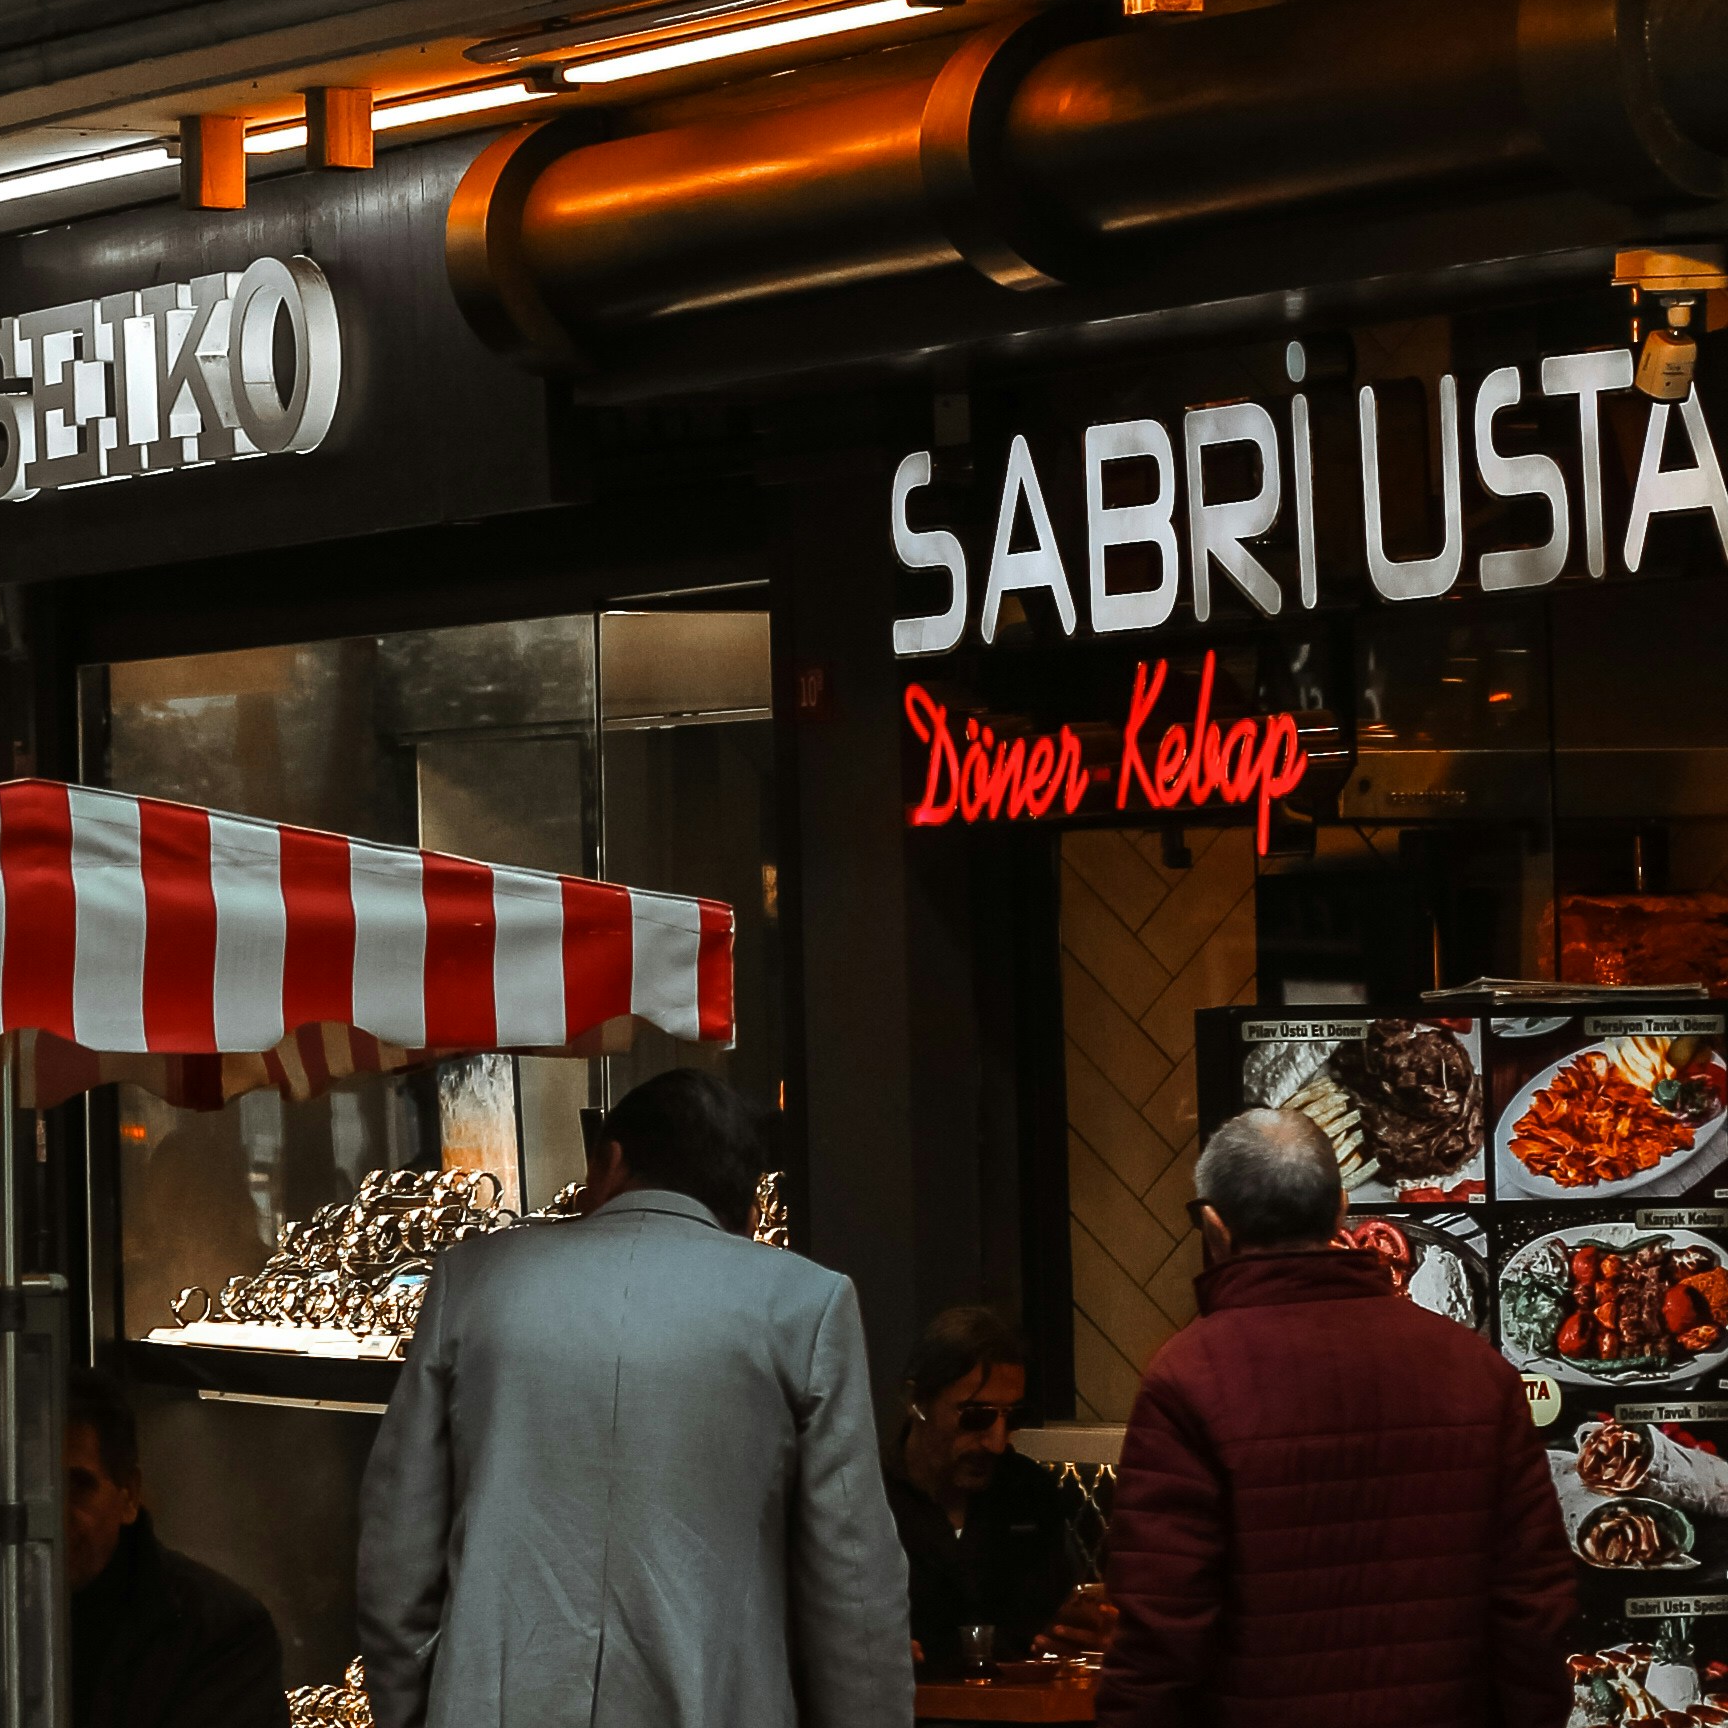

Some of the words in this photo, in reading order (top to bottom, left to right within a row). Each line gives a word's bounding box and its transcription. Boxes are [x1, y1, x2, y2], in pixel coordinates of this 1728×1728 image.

[890, 340, 1318, 657] SABRİ
[1358, 348, 1728, 602] USTA
[904, 680, 1091, 828] Döner
[1117, 648, 1309, 857] Kebap
[1280, 1022, 1310, 1038] Üstü
[1312, 1024, 1325, 1038] Et
[1327, 1024, 1363, 1038] Döner
[1663, 1600, 1691, 1614] Usta
